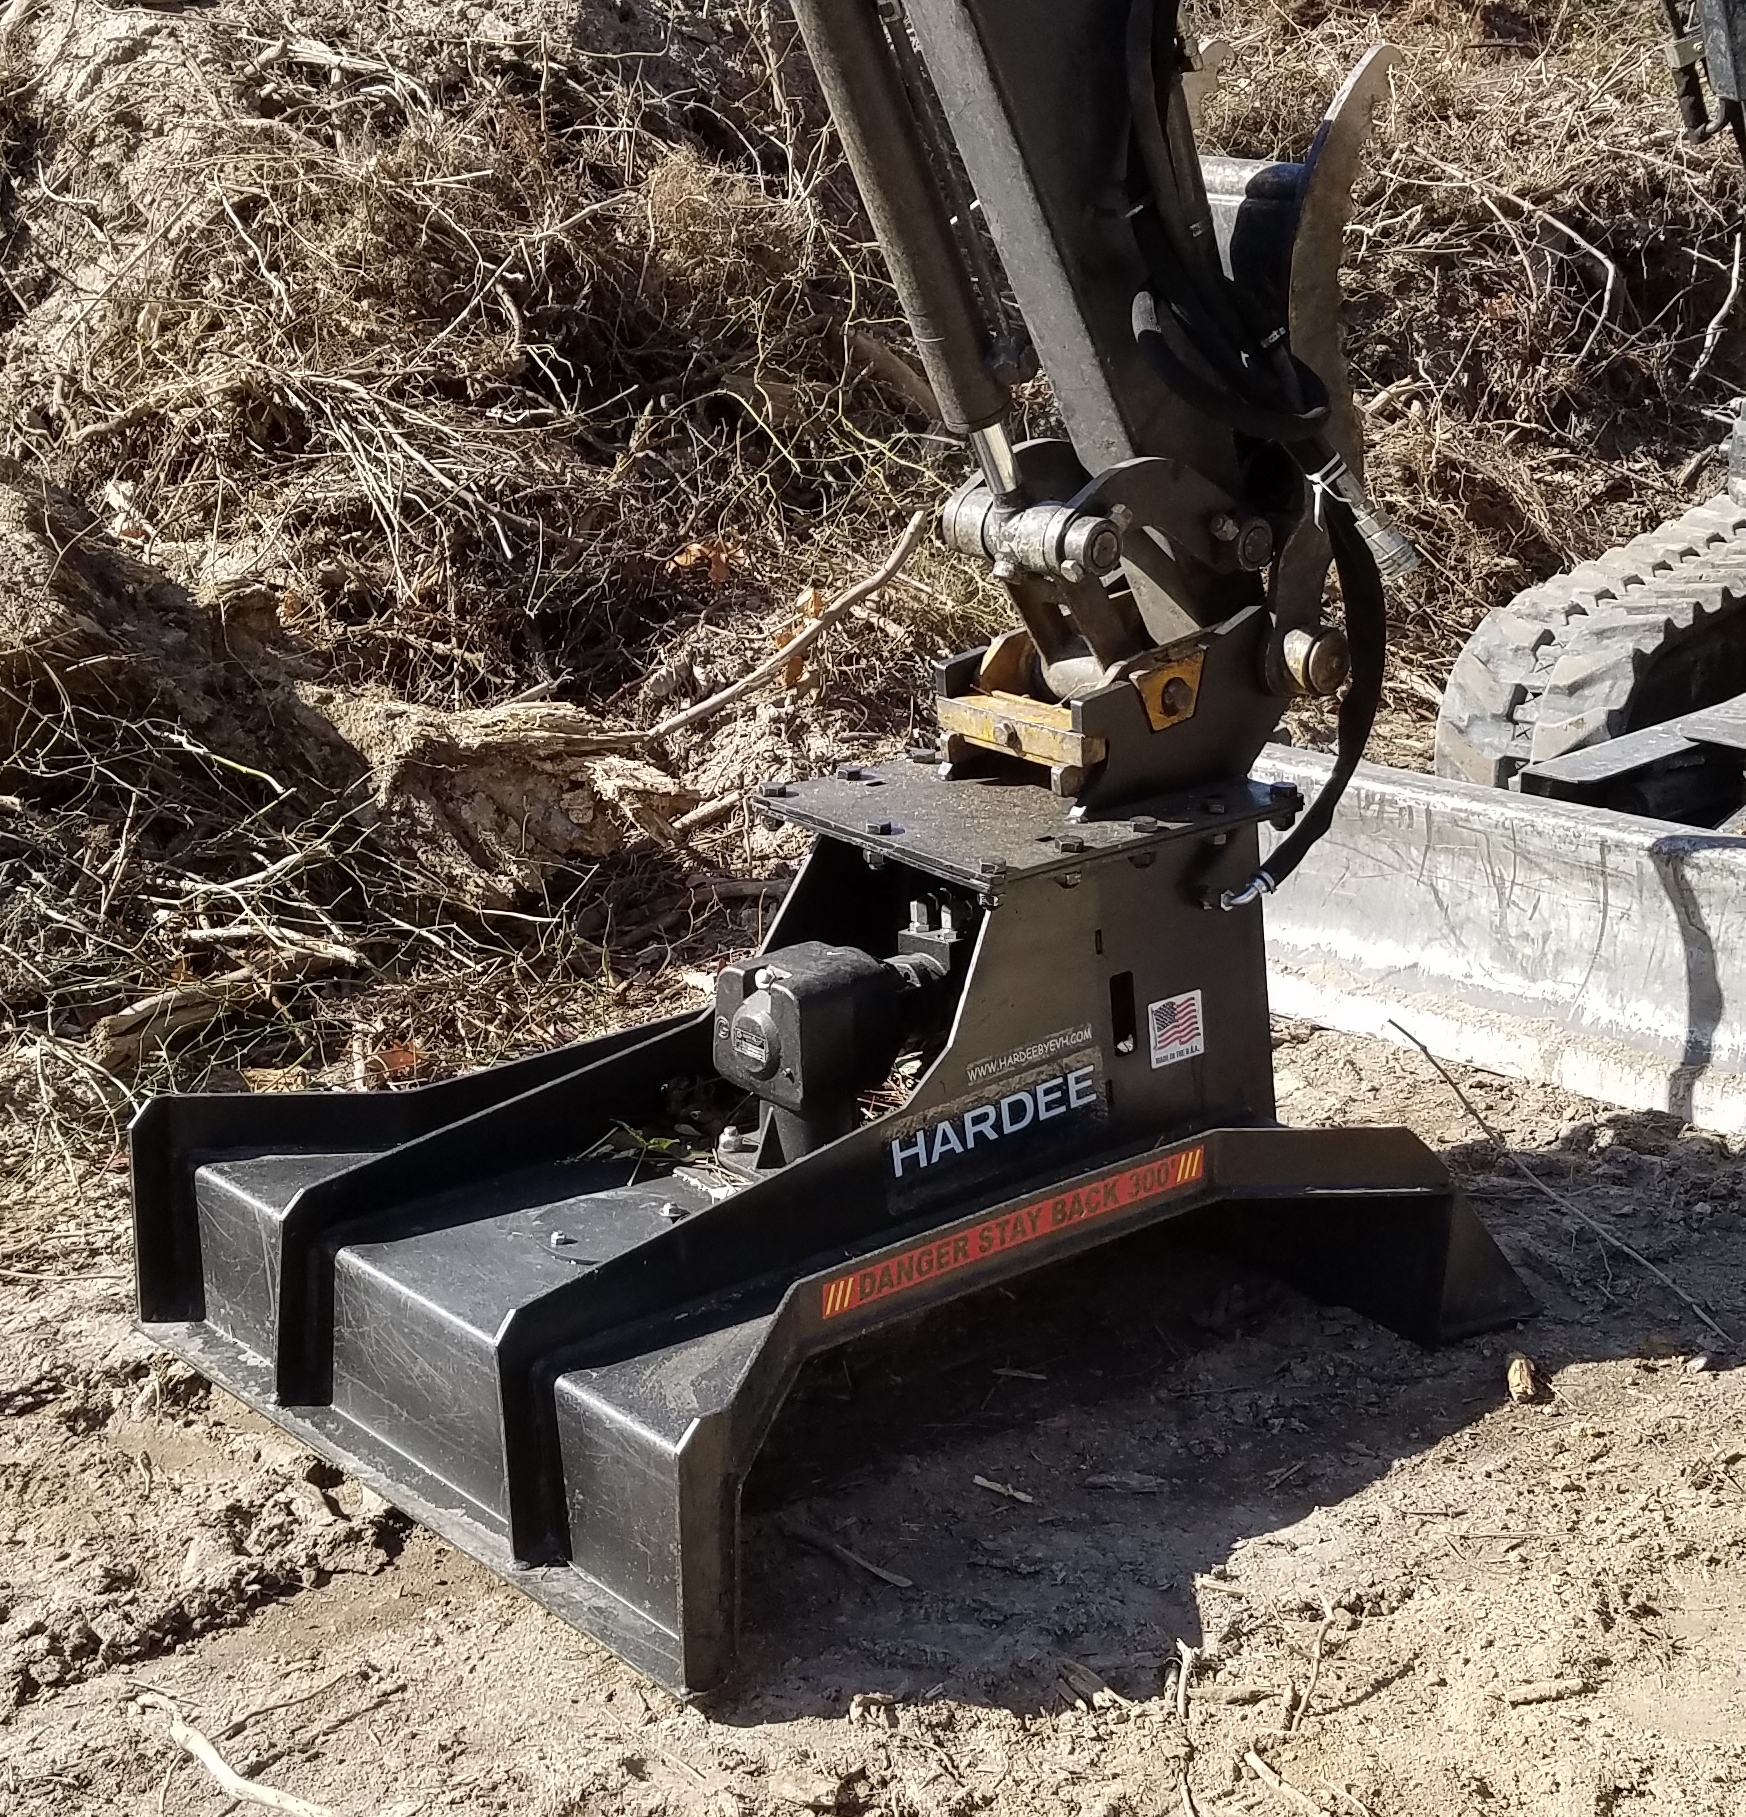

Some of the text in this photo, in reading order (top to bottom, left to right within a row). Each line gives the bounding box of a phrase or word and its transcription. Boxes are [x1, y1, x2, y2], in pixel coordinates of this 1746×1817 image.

[967, 1027, 1093, 1082] WWW.HARDEEBYEVH.COM
[890, 1064, 1097, 1178] HARDEE
[859, 1234, 970, 1301] DANGER
[978, 1207, 1042, 1253] STAY
[1051, 1178, 1119, 1226] BACK
